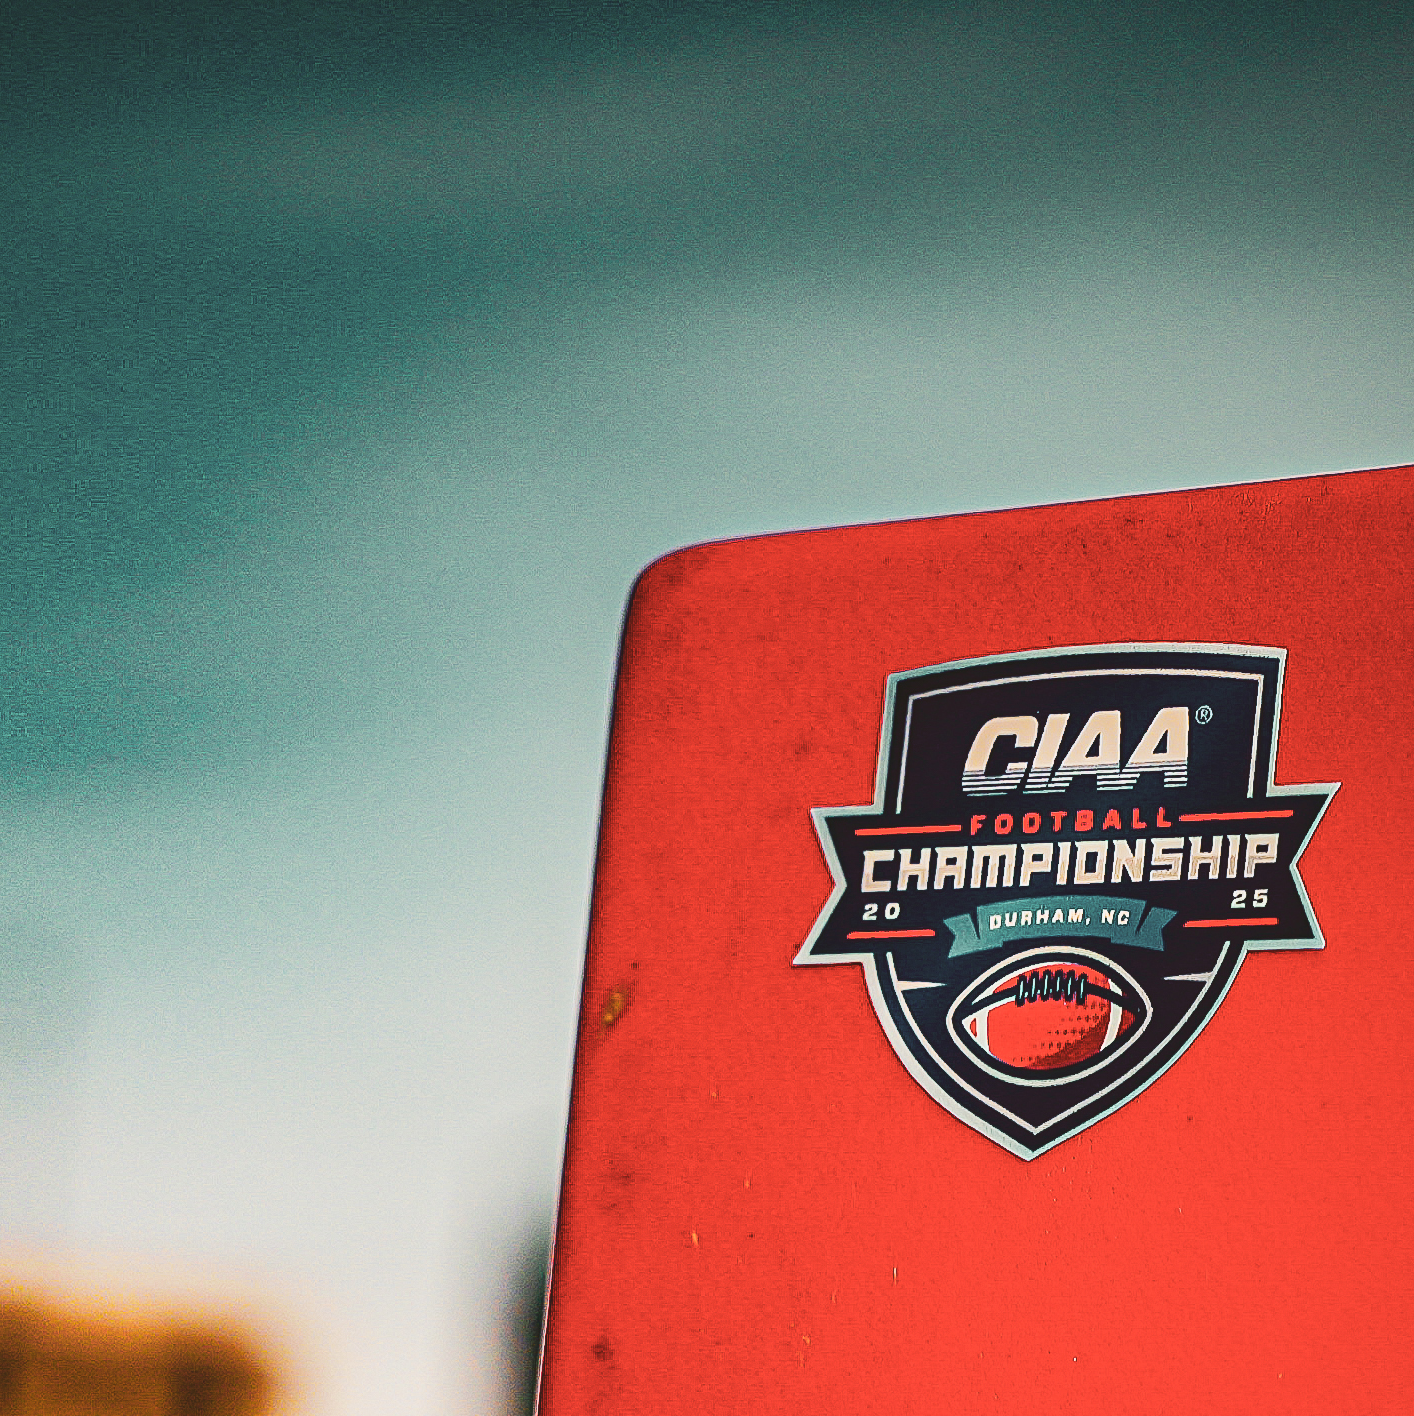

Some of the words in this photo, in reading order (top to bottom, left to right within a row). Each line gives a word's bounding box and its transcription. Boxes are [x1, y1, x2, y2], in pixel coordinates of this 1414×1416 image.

[970, 806, 1173, 836] FOOTBALL
[860, 832, 1280, 893] CHAMPIONSHIP
[1229, 888, 1269, 909] 25
[861, 902, 901, 921] 20
[988, 907, 1092, 931] DURHAM,
[1100, 908, 1130, 926] NC
